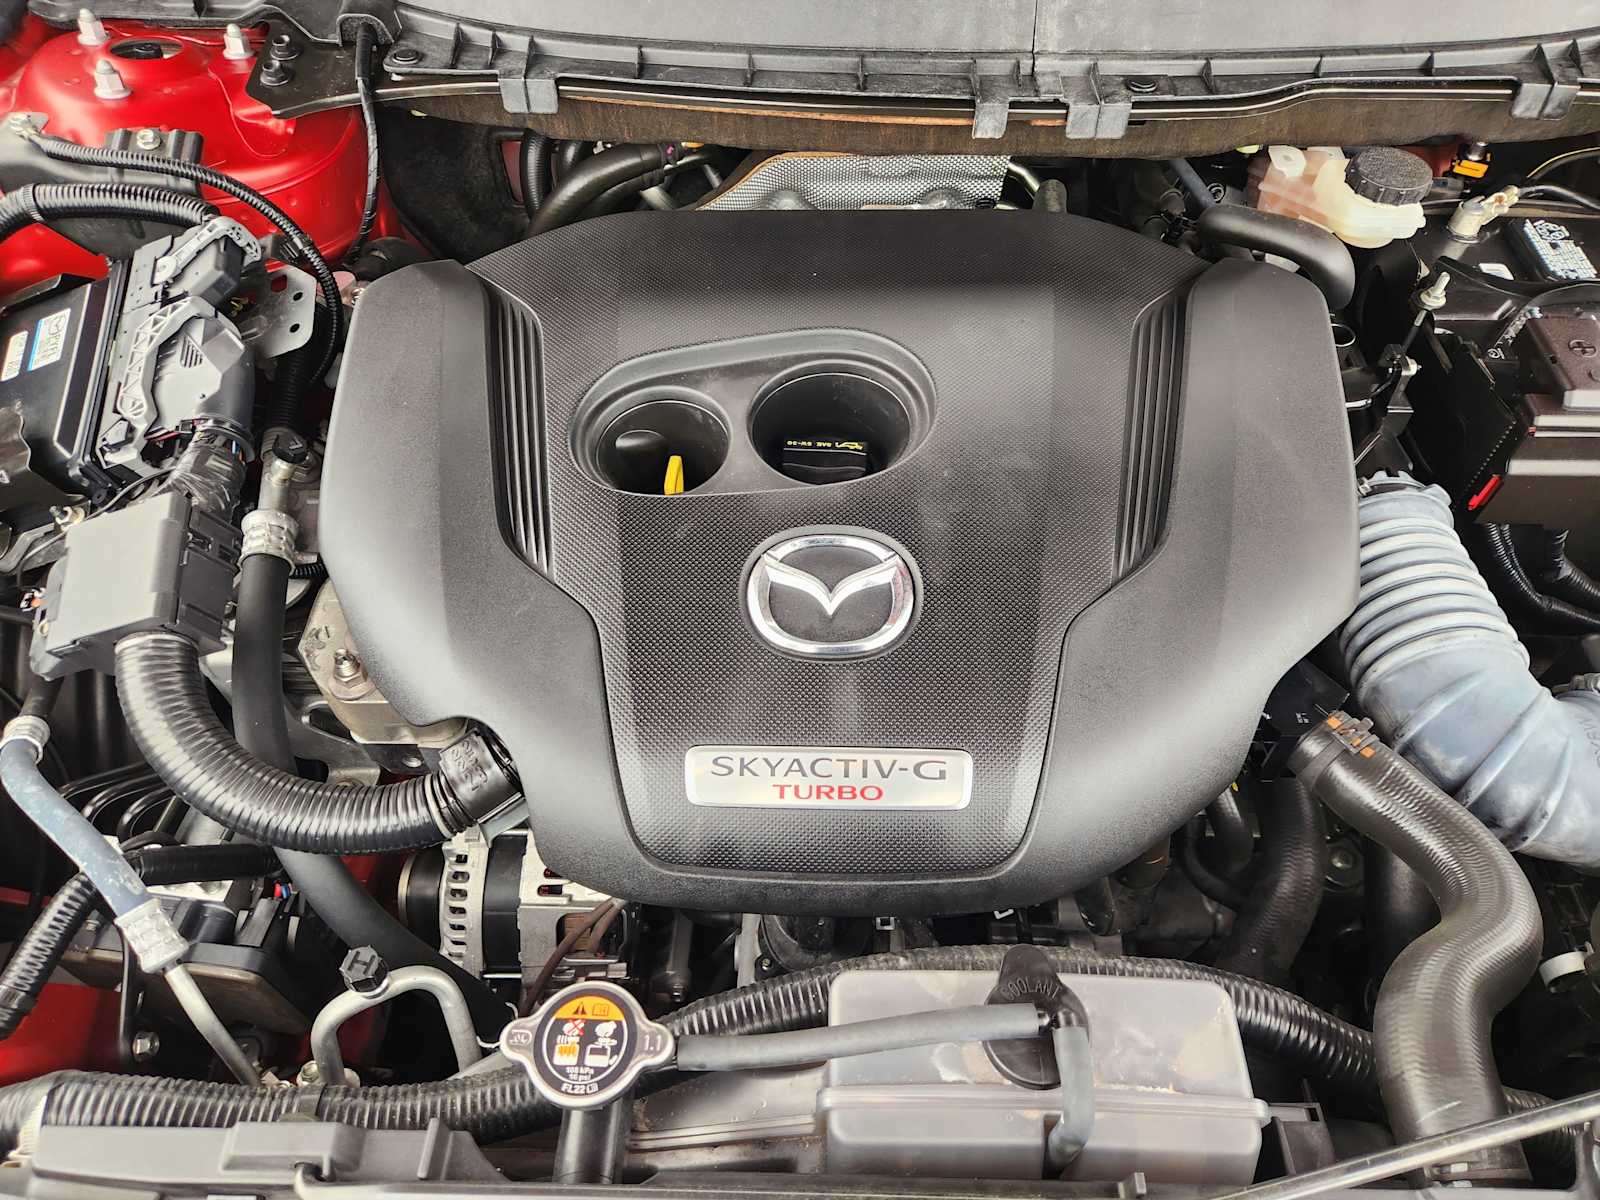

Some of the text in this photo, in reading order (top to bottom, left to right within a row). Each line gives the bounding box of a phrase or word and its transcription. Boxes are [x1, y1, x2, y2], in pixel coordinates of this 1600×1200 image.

[710, 756, 947, 781] SKYACTIV-G
[772, 784, 884, 801] TURBO
[347, 950, 376, 976] H
[1006, 976, 1062, 1000] COOLANT
[643, 1033, 662, 1051] 1.1
[561, 1083, 585, 1094] FL22
